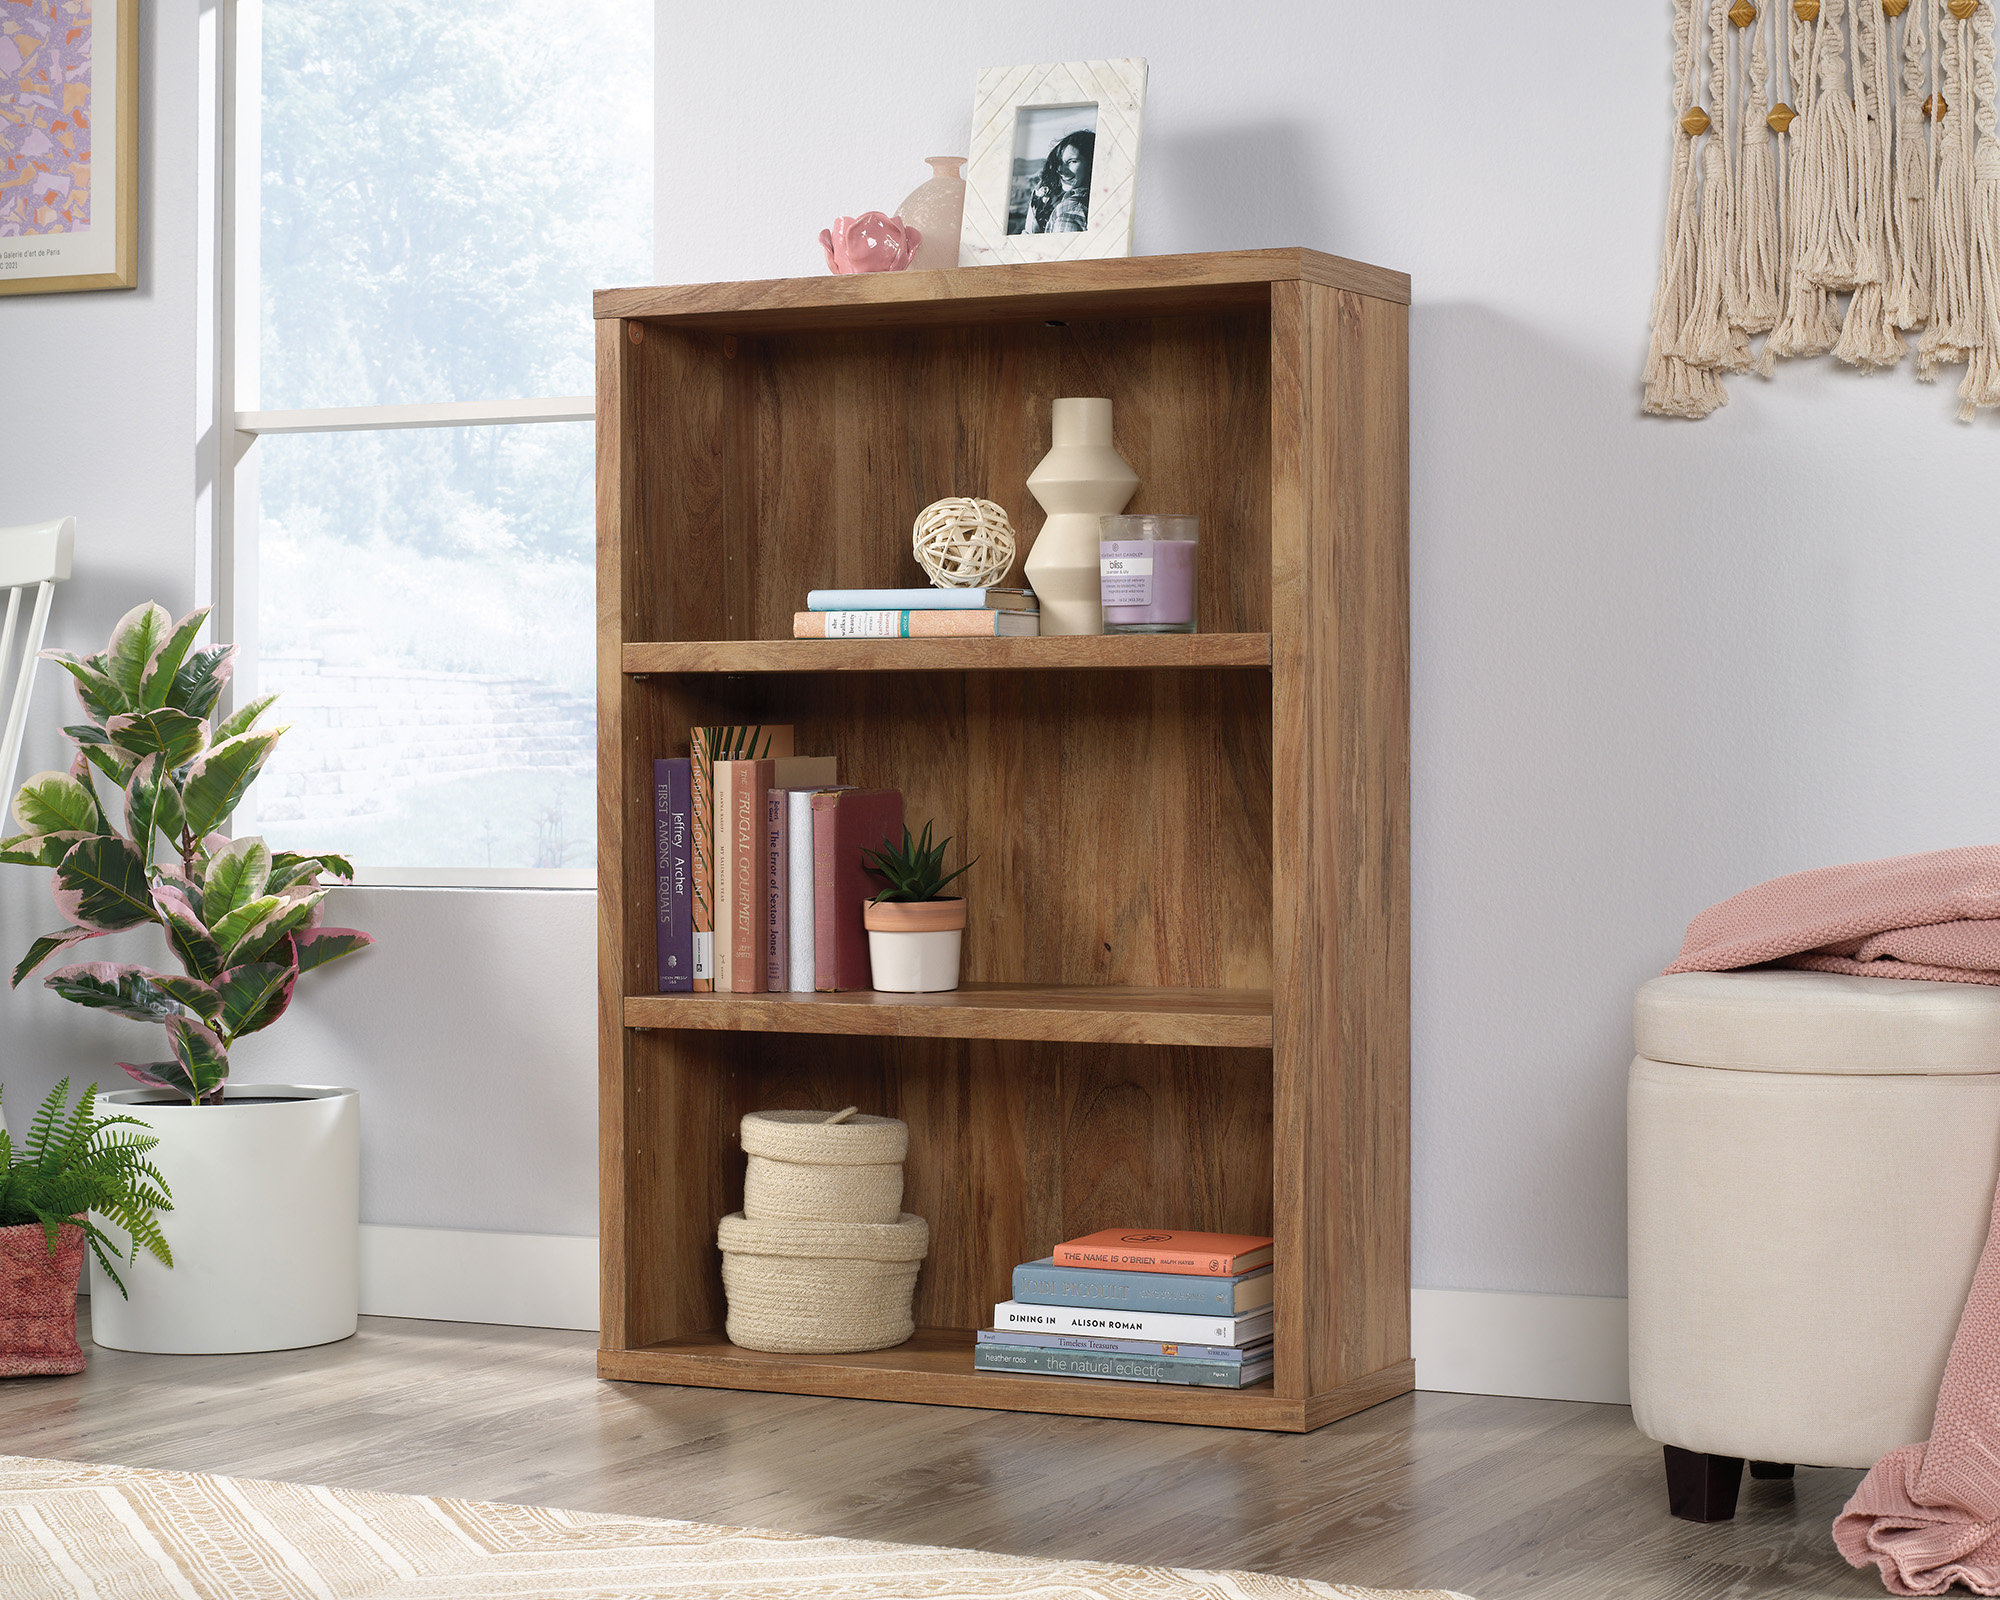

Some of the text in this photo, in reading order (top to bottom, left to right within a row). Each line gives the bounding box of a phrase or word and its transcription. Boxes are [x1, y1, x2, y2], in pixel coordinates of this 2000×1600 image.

[3, 251, 23, 259] Galerie
[23, 250, 37, 258] d'art
[5, 261, 18, 270] 2021
[1109, 560, 1123, 569] bliss
[849, 614, 857, 634] beauty
[692, 739, 703, 898] THE INSPIRED HOUSEPLANT
[738, 790, 750, 853] FRUGAL
[770, 830, 779, 848] The
[658, 784, 670, 924] FIRST AMONG EQUALS
[671, 812, 686, 895] Jeffrey Archer
[720, 846, 725, 854] MY
[770, 852, 779, 876] Error
[770, 879, 779, 890] of
[738, 856, 750, 935] GOURMET
[770, 893, 779, 925] Sexton
[769, 929, 779, 956] Jones
[1064, 1252, 1081, 1260] THE
[1083, 1253, 1108, 1262] NAME
[1110, 1255, 1119, 1263] IS
[1121, 1256, 1156, 1265] O'BRIEN
[1020, 1277, 1056, 1296] JODI
[1062, 1281, 1130, 1300] PICOULT
[1009, 1314, 1043, 1323] DINING
[1071, 1319, 1105, 1328] ALISON
[1108, 1321, 1142, 1330] ROMAN
[1058, 1338, 1087, 1348] Timeless
[1087, 1340, 1119, 1350] Treasures
[985, 1352, 1012, 1362] heather
[1012, 1356, 1027, 1364] ross
[1046, 1356, 1067, 1370] the
[1070, 1358, 1113, 1373] natural
[1115, 1361, 1165, 1378] eclectic
